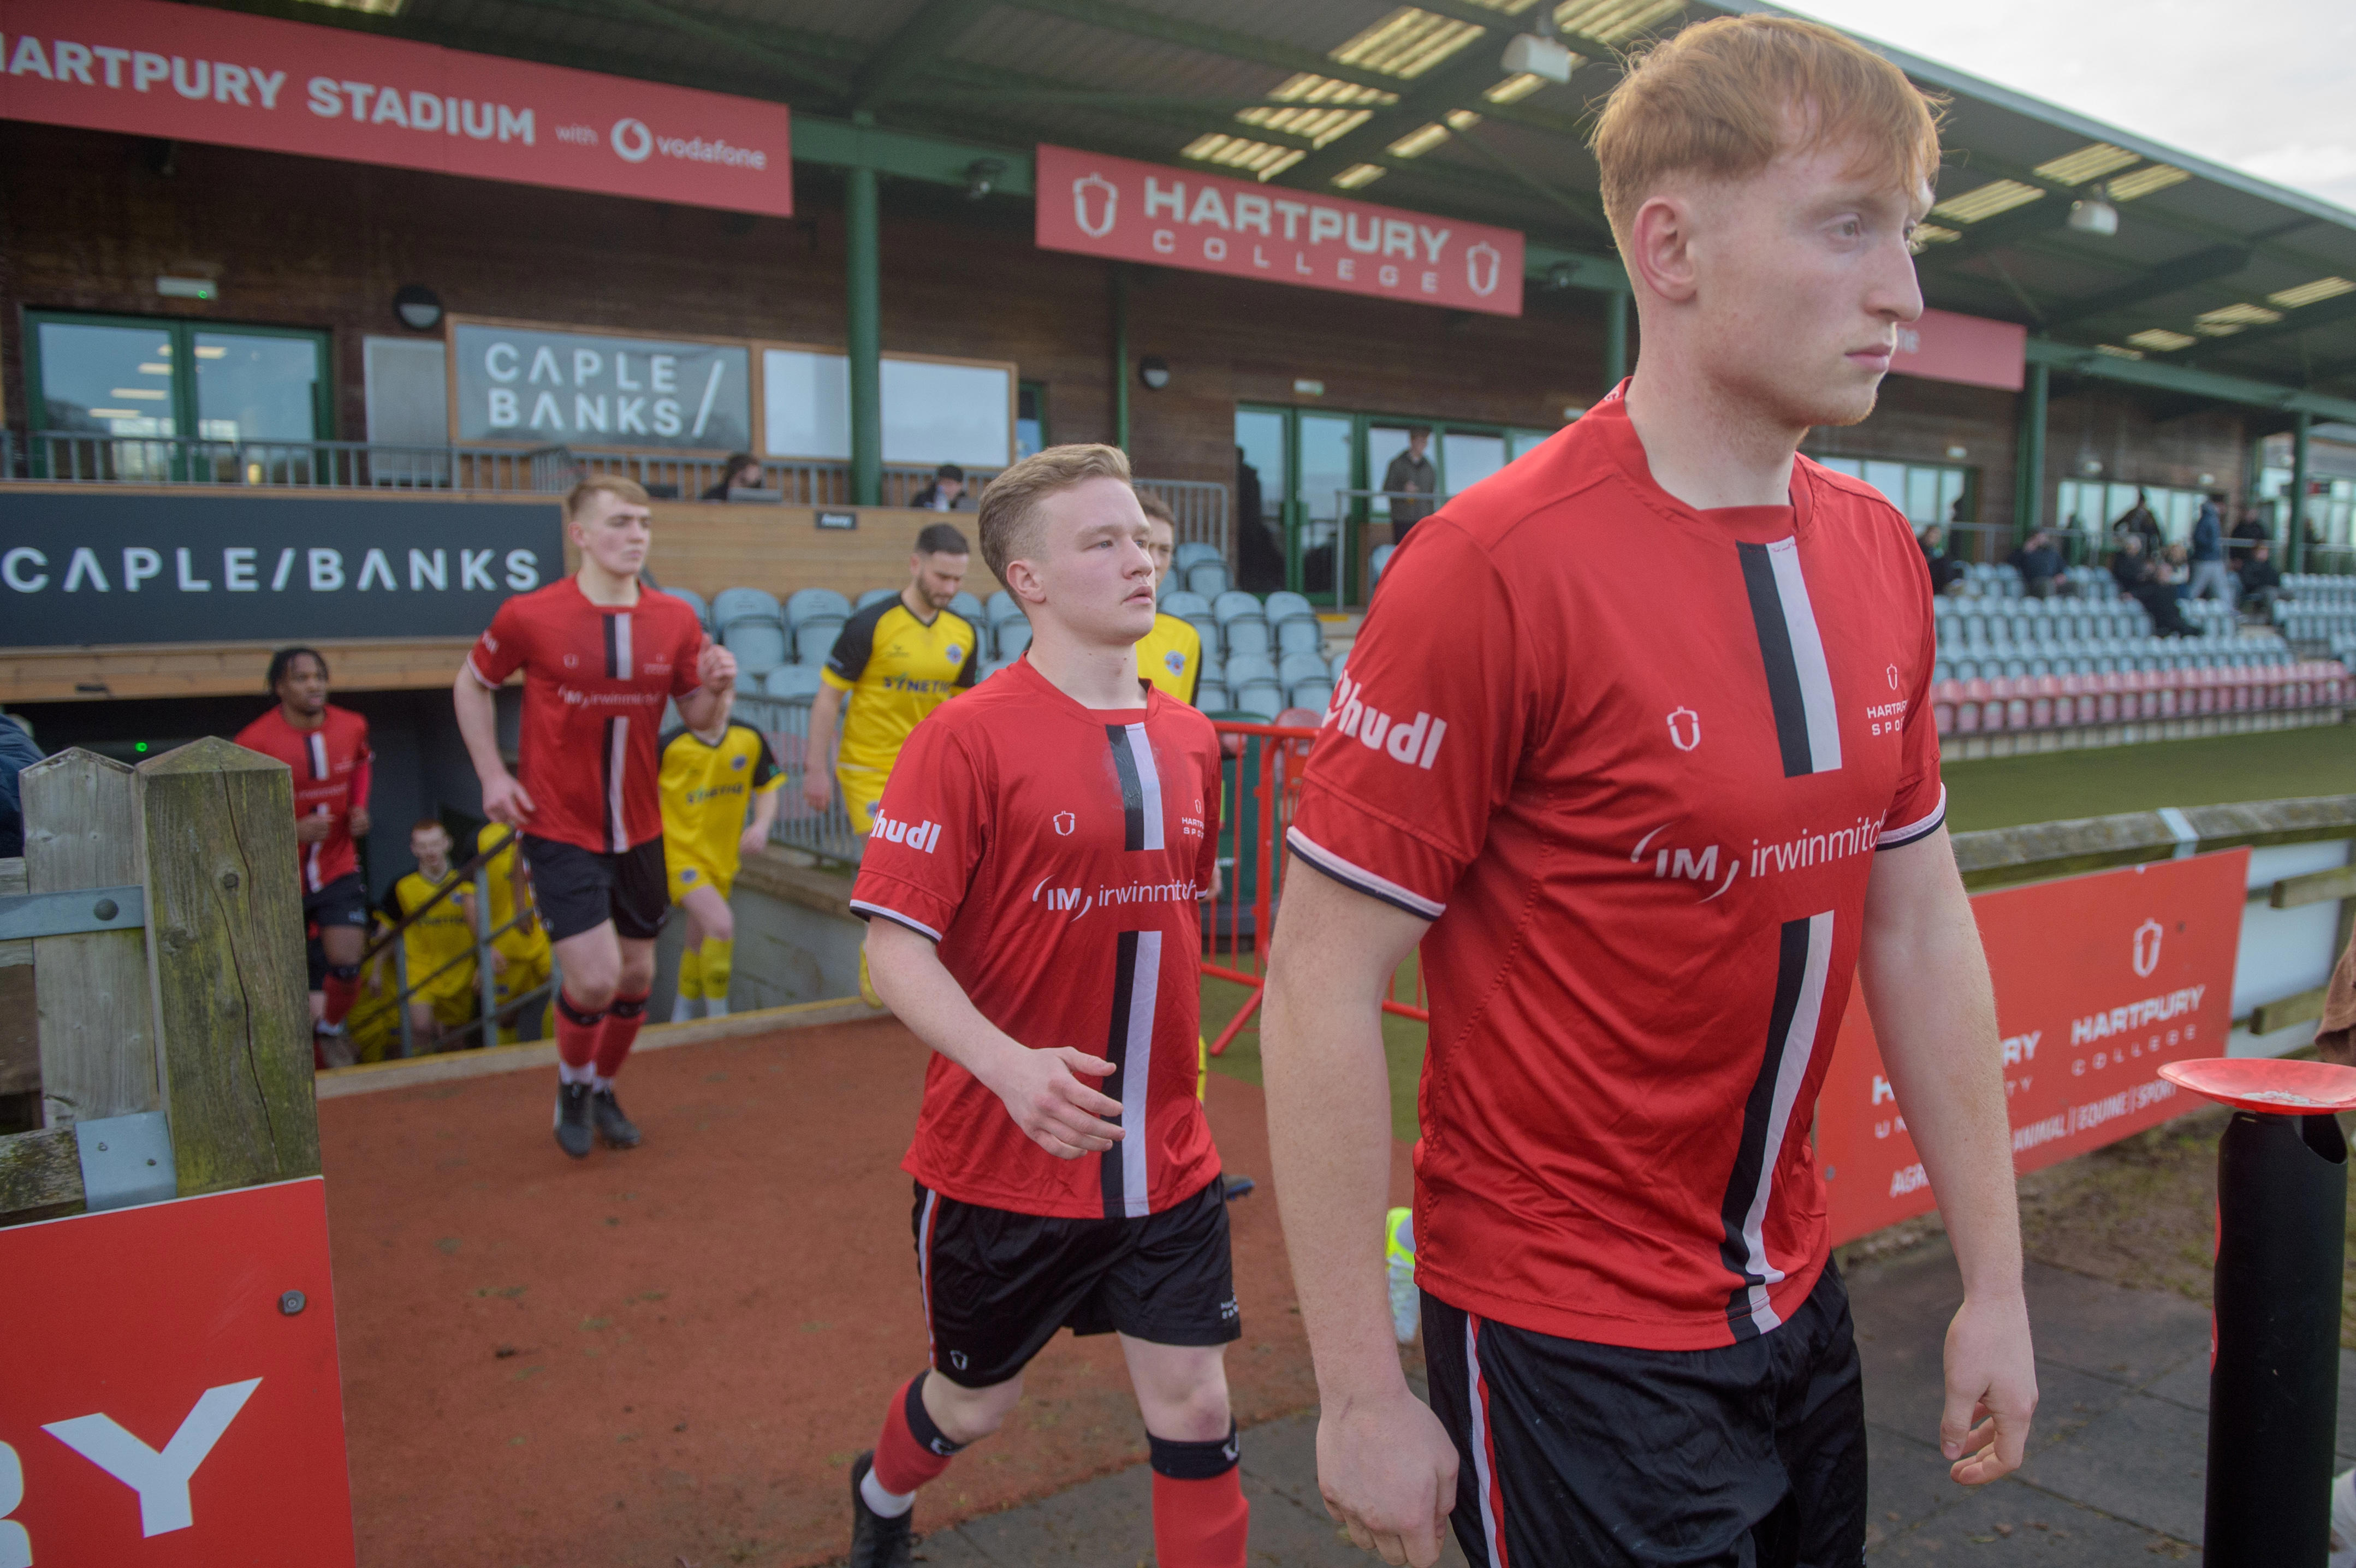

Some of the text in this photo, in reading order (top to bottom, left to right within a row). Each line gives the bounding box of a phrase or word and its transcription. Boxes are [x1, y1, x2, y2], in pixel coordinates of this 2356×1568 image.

[0, 32, 767, 170] ARTPURY STADIUM with vodafone
[1144, 176, 1450, 264] HARTPURY
[1152, 229, 1438, 294] COLLEGE
[485, 342, 678, 394] CAPLE
[1338, 682, 1447, 770] hudl
[870, 809, 942, 854] hudl
[2071, 984, 2205, 1047] HARTPURY
[2071, 1024, 2196, 1076] COLLEGE
